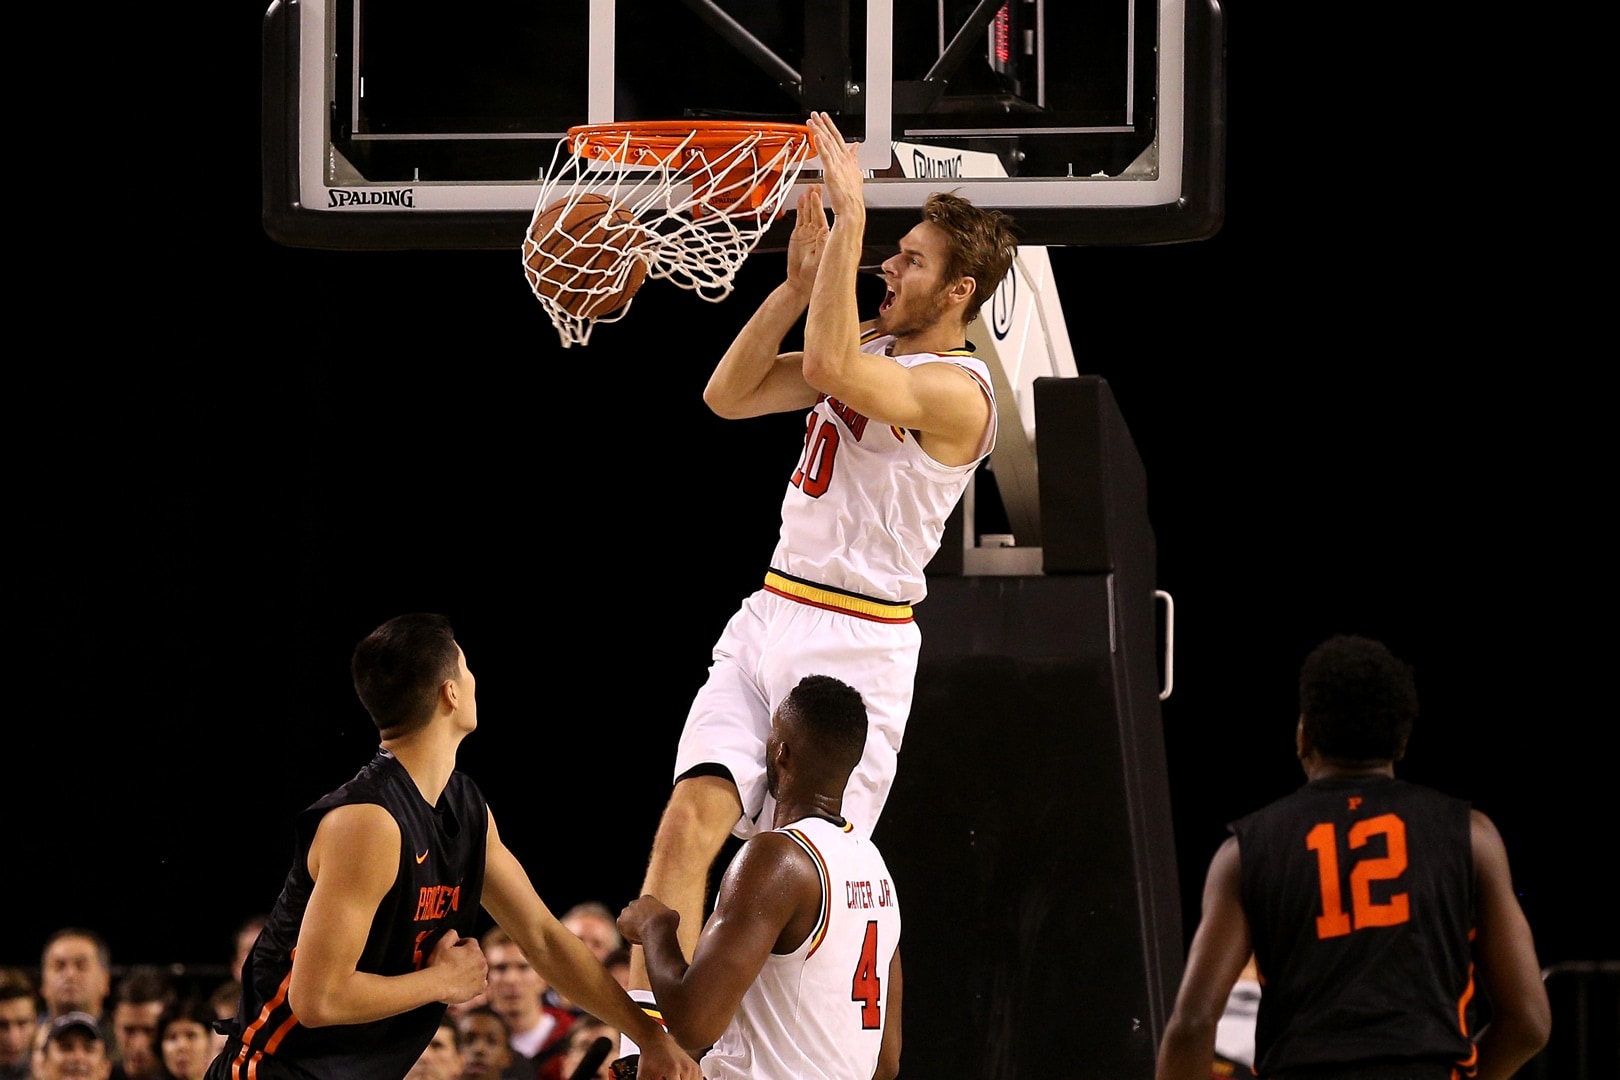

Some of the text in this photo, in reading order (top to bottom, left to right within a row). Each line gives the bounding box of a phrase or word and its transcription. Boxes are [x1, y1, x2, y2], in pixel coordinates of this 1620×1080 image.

[328, 189, 413, 208] SPALDING
[790, 411, 841, 499] 10
[1348, 797, 1363, 810] P
[1306, 813, 1410, 940] 12
[851, 920, 880, 1030] 4
